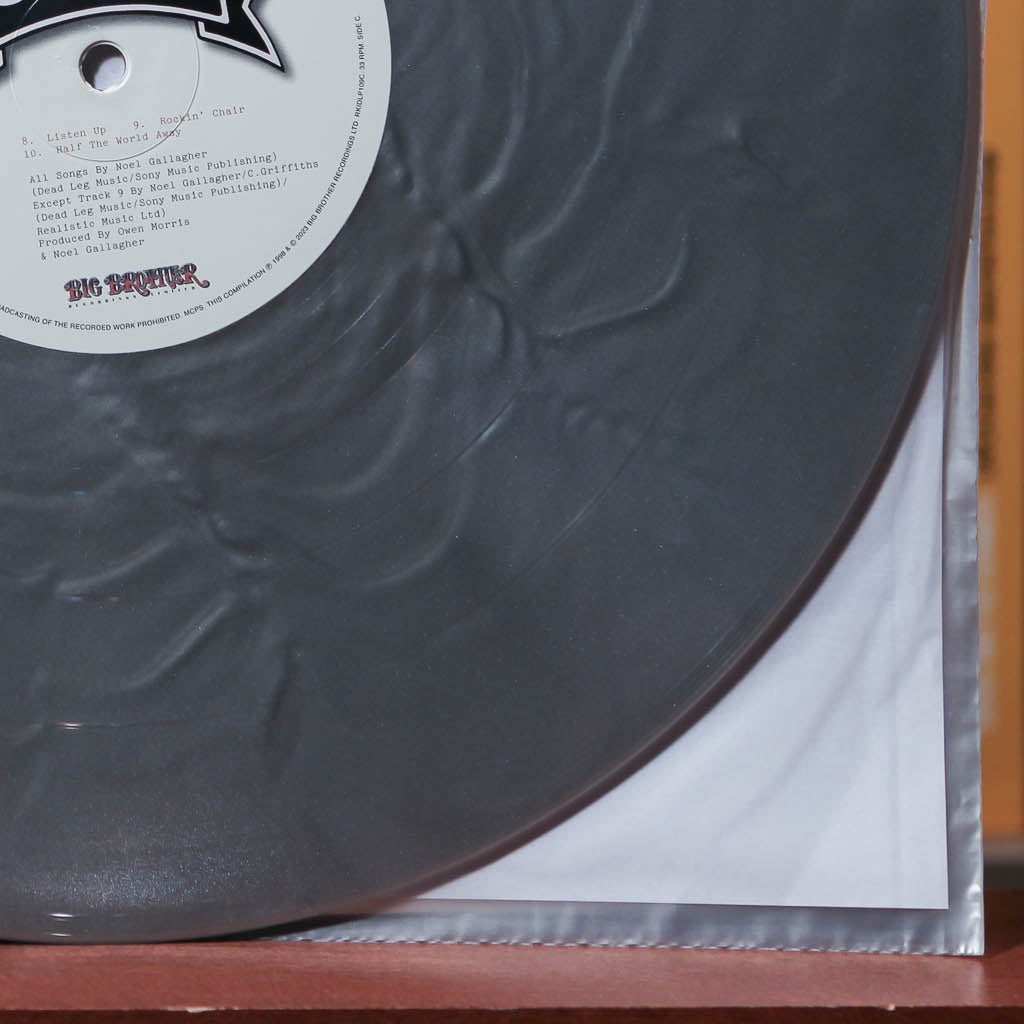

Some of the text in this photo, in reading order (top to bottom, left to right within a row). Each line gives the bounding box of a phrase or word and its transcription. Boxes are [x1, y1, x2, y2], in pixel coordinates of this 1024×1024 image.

[133, 106, 245, 129] 9. Rockin' Chair
[22, 127, 106, 145] 8. Listen Up
[25, 127, 181, 158] 10. Half The World Away
[30, 152, 207, 183] All Songs By Noel Gallagher
[33, 152, 276, 197] (Dead Leg Music/Sony Music Publishing)
[33, 162, 318, 209] Except Track 9 By Noel Gallagher/C.Griffiths
[36, 178, 286, 224] (Dead Leg Music/Sony Music Publishing)/
[37, 208, 165, 235] Realistic Music Ltd)
[39, 219, 190, 247] Produced By Owen Morris
[54, 320, 68, 328] THE
[70, 323, 111, 331] RECORDED
[206, 296, 222, 306] THIS
[223, 268, 266, 299] COMPILATION
[273, 250, 286, 264] 1998
[296, 226, 309, 240] 2023
[307, 214, 317, 226] BIG
[315, 182, 336, 214] BROTHER
[333, 136, 355, 182] RECORDINGS
[41, 240, 144, 260] & Noel Gallagher
[64, 276, 103, 302] BIG
[104, 263, 210, 297] BROTHER
